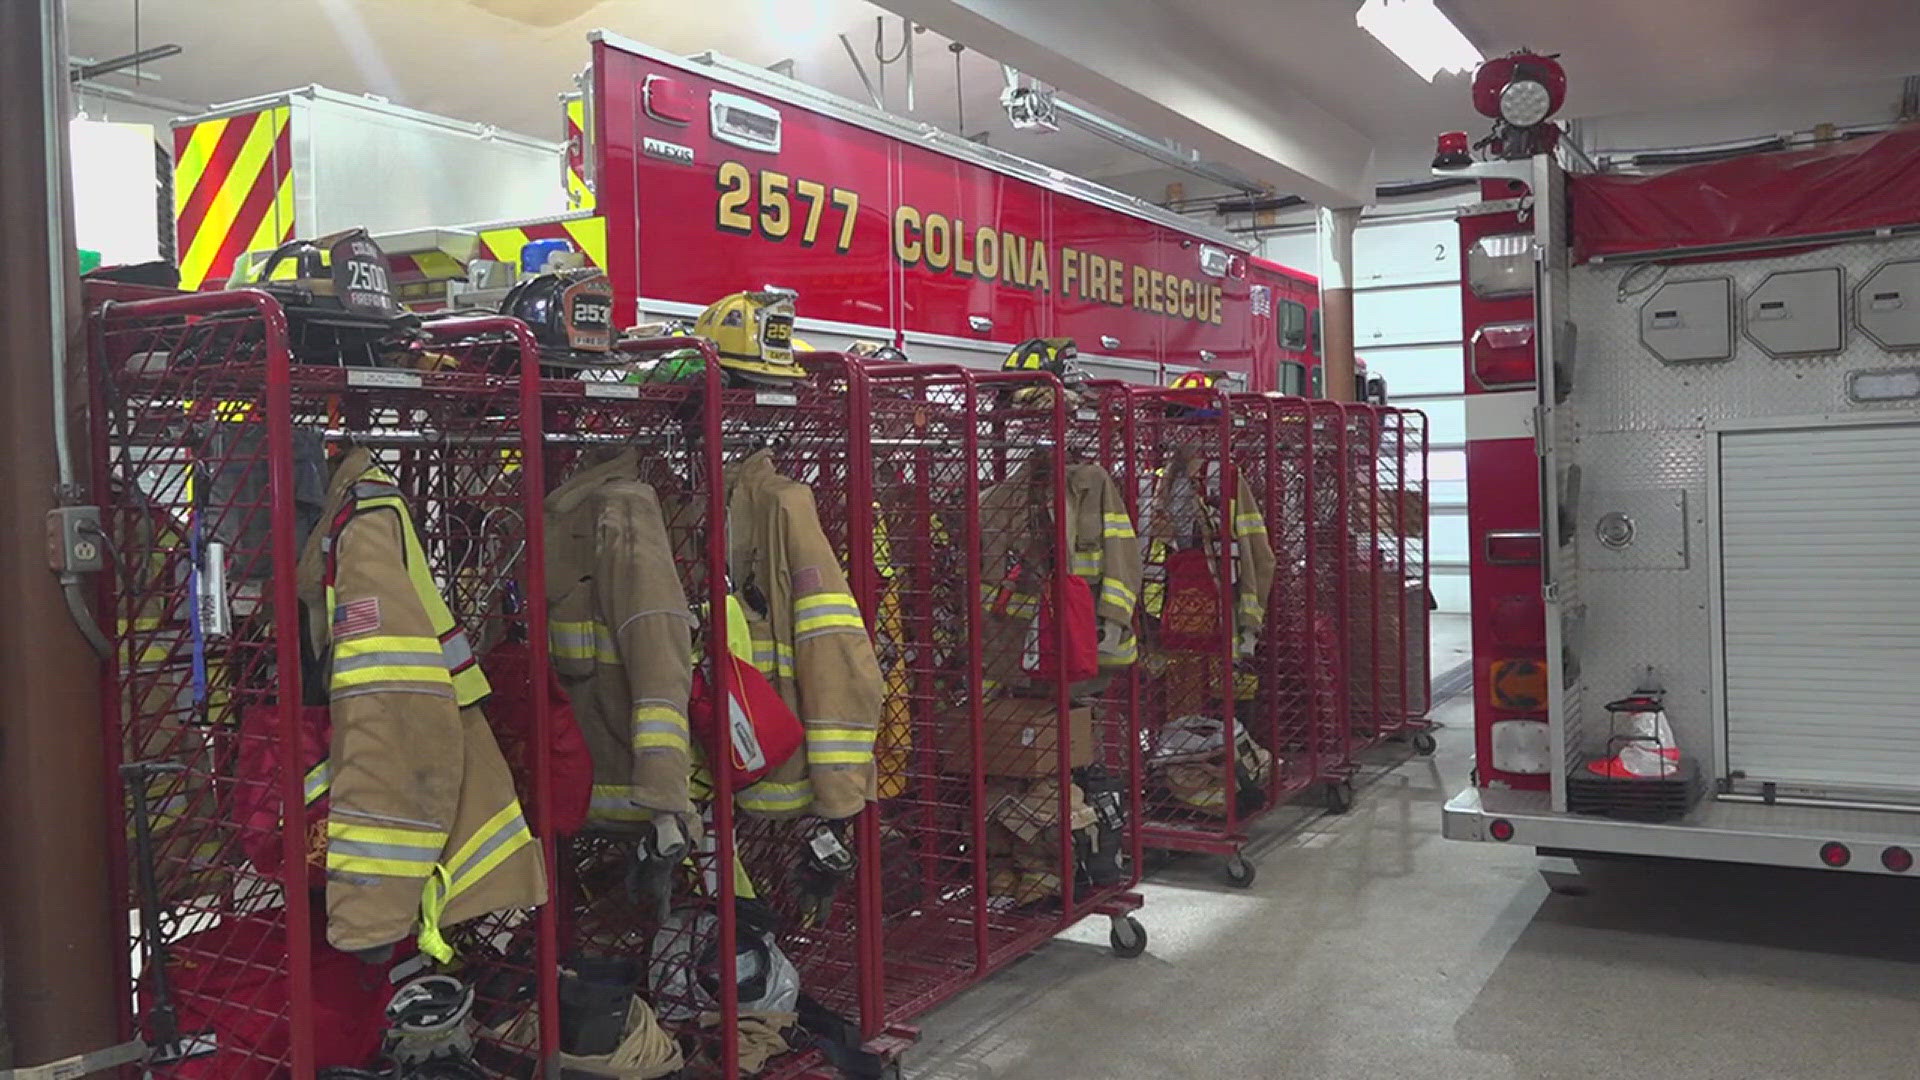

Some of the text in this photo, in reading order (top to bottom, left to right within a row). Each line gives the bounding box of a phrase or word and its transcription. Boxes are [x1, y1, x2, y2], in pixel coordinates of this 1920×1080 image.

[645, 141, 692, 163] ALEXIS
[716, 161, 859, 254] 2577
[1434, 243, 1446, 261] 2
[894, 205, 1223, 325] COLONA FIRE RESCUE
[766, 322, 792, 340] 25
